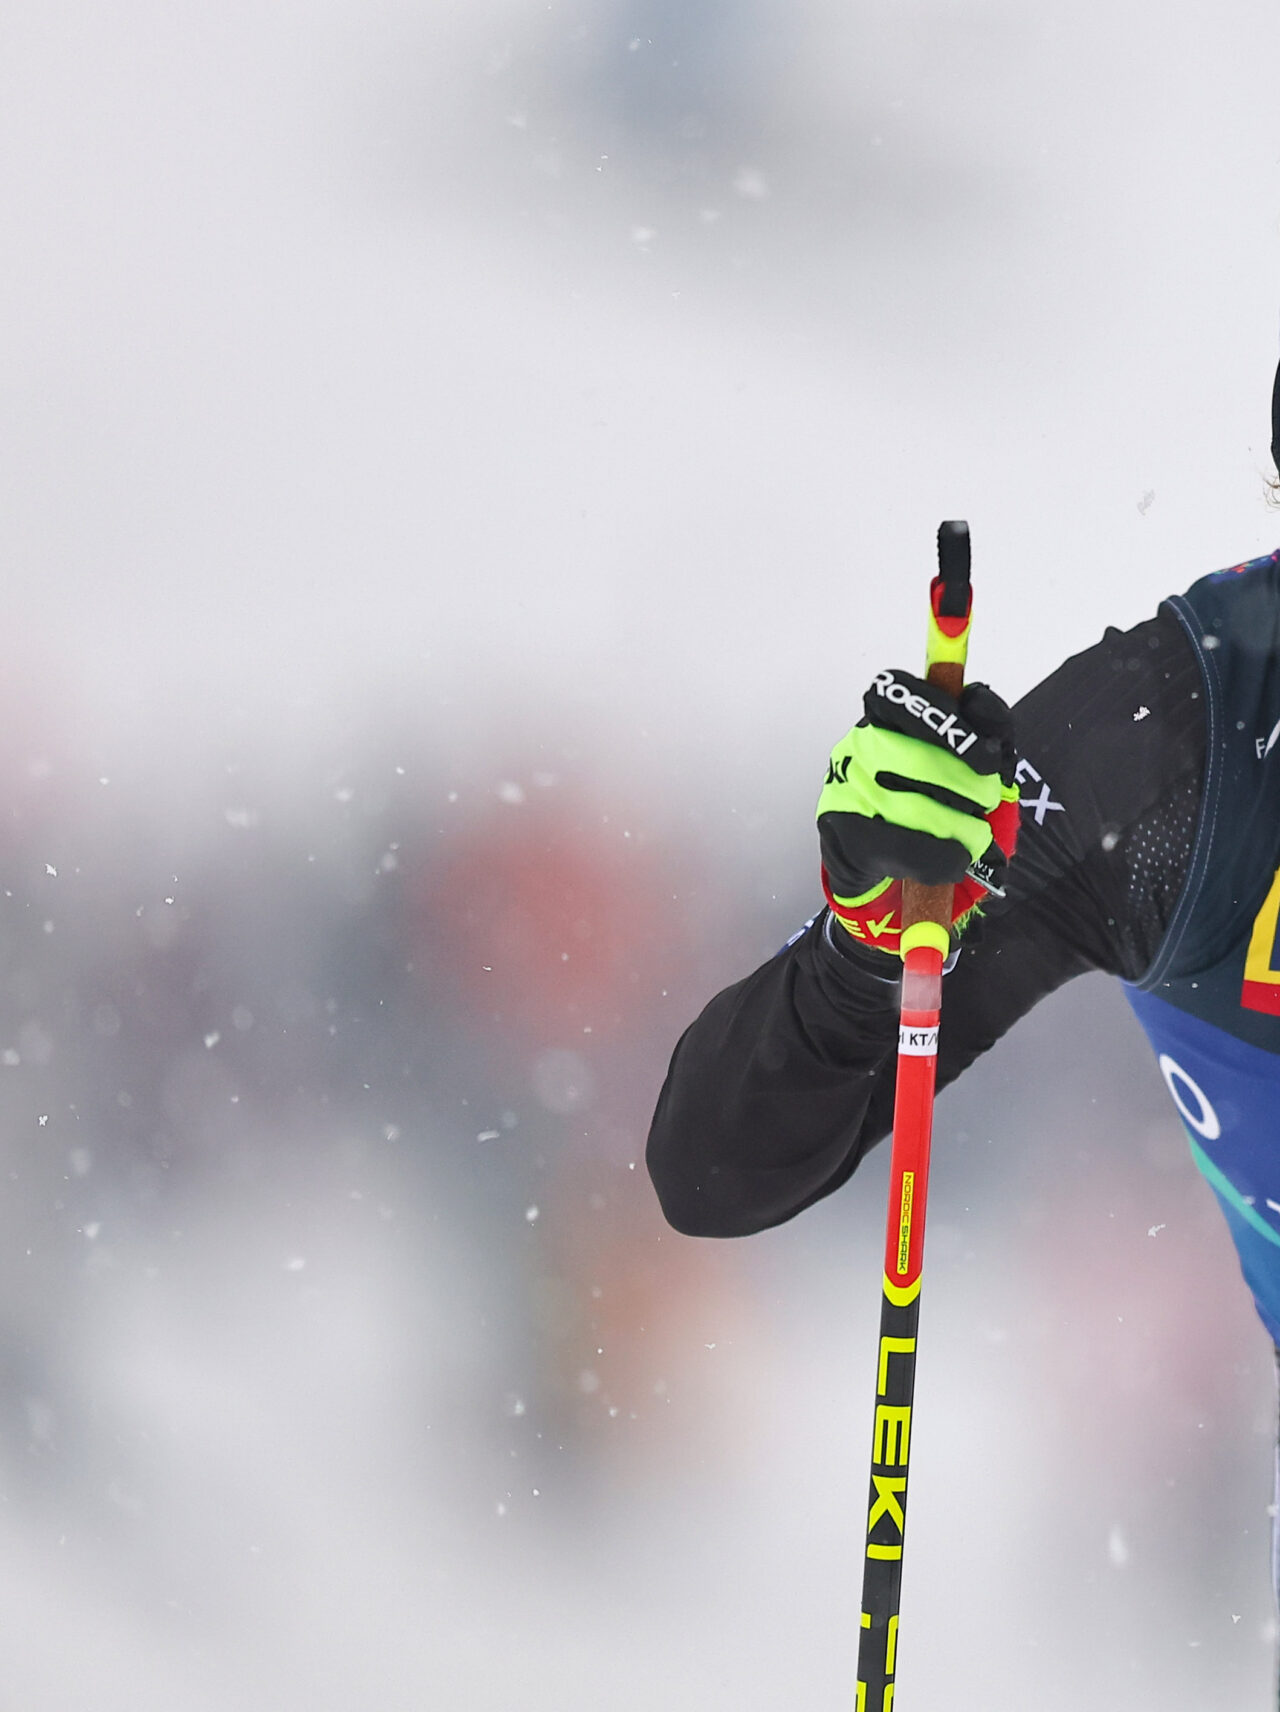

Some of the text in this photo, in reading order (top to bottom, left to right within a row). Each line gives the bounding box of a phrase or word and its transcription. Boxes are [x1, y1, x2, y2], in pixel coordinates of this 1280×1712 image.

[898, 1174, 912, 1271] NORDIC SHARK
[866, 1336, 916, 1561] LEKI
